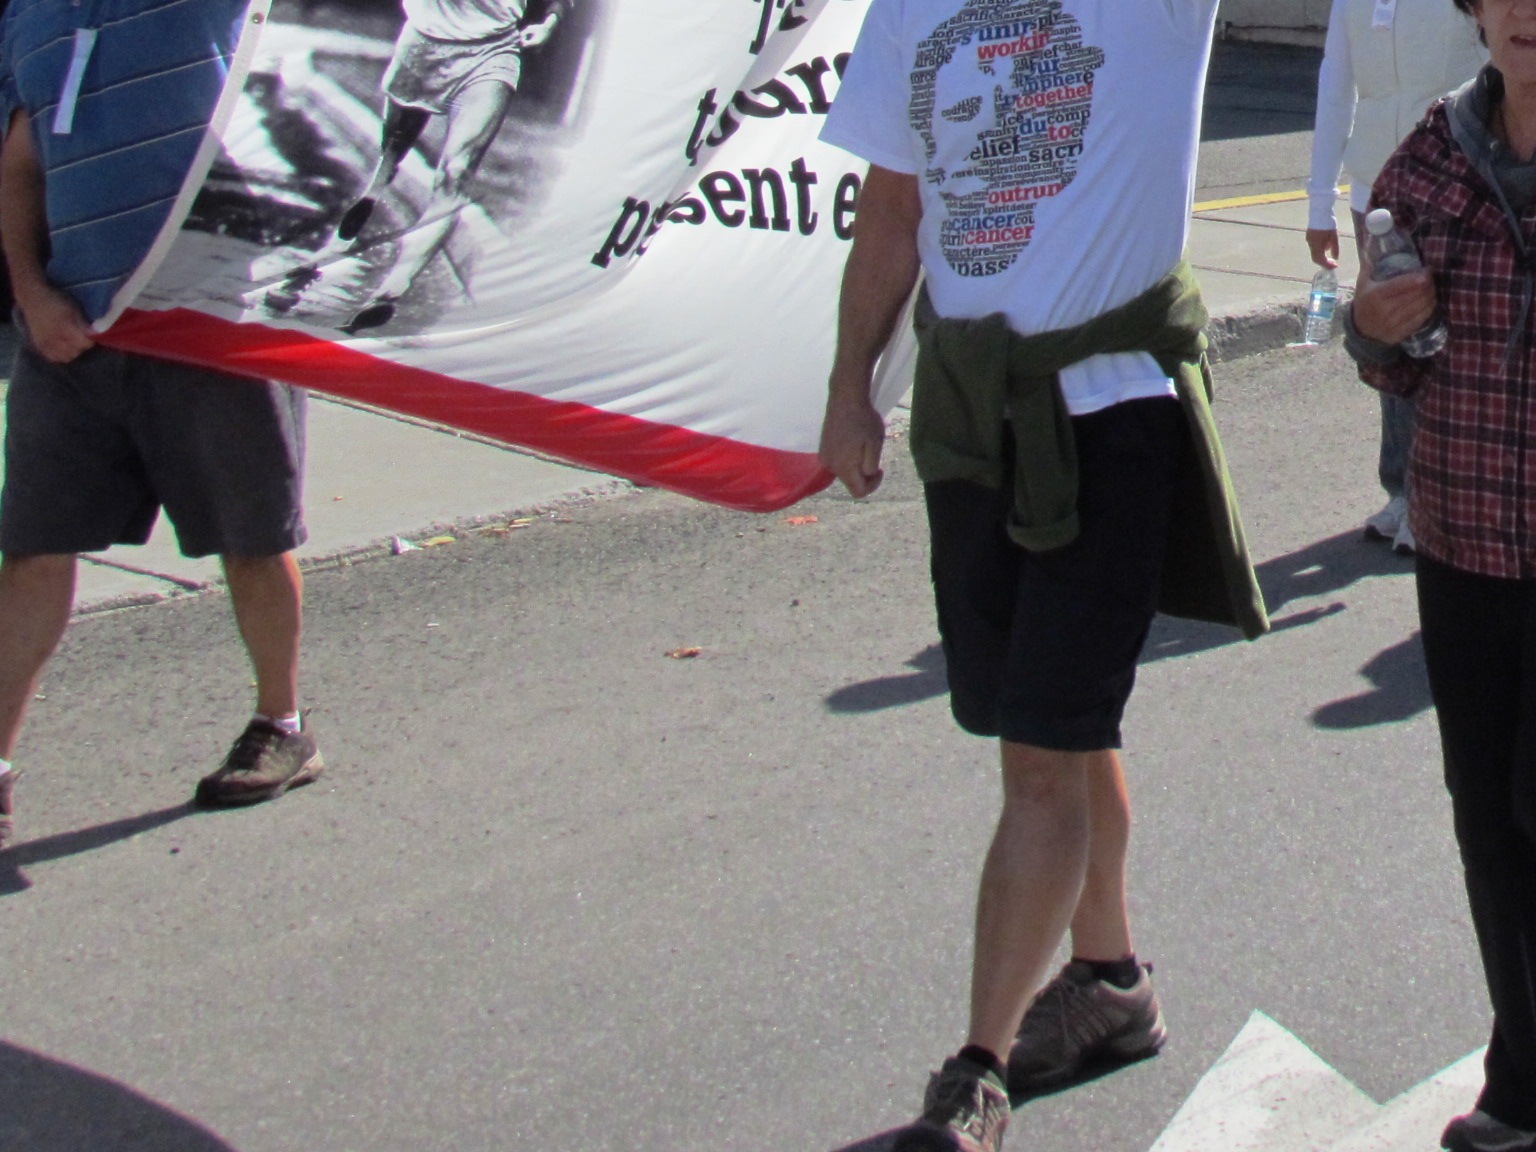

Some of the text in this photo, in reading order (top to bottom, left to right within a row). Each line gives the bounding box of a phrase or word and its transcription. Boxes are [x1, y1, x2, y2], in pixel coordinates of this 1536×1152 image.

[977, 31, 1051, 60] workin
[1020, 118, 1047, 135] du
[1047, 125, 1071, 141] to
[952, 214, 1016, 231] cancer
[964, 225, 1035, 245] cancer
